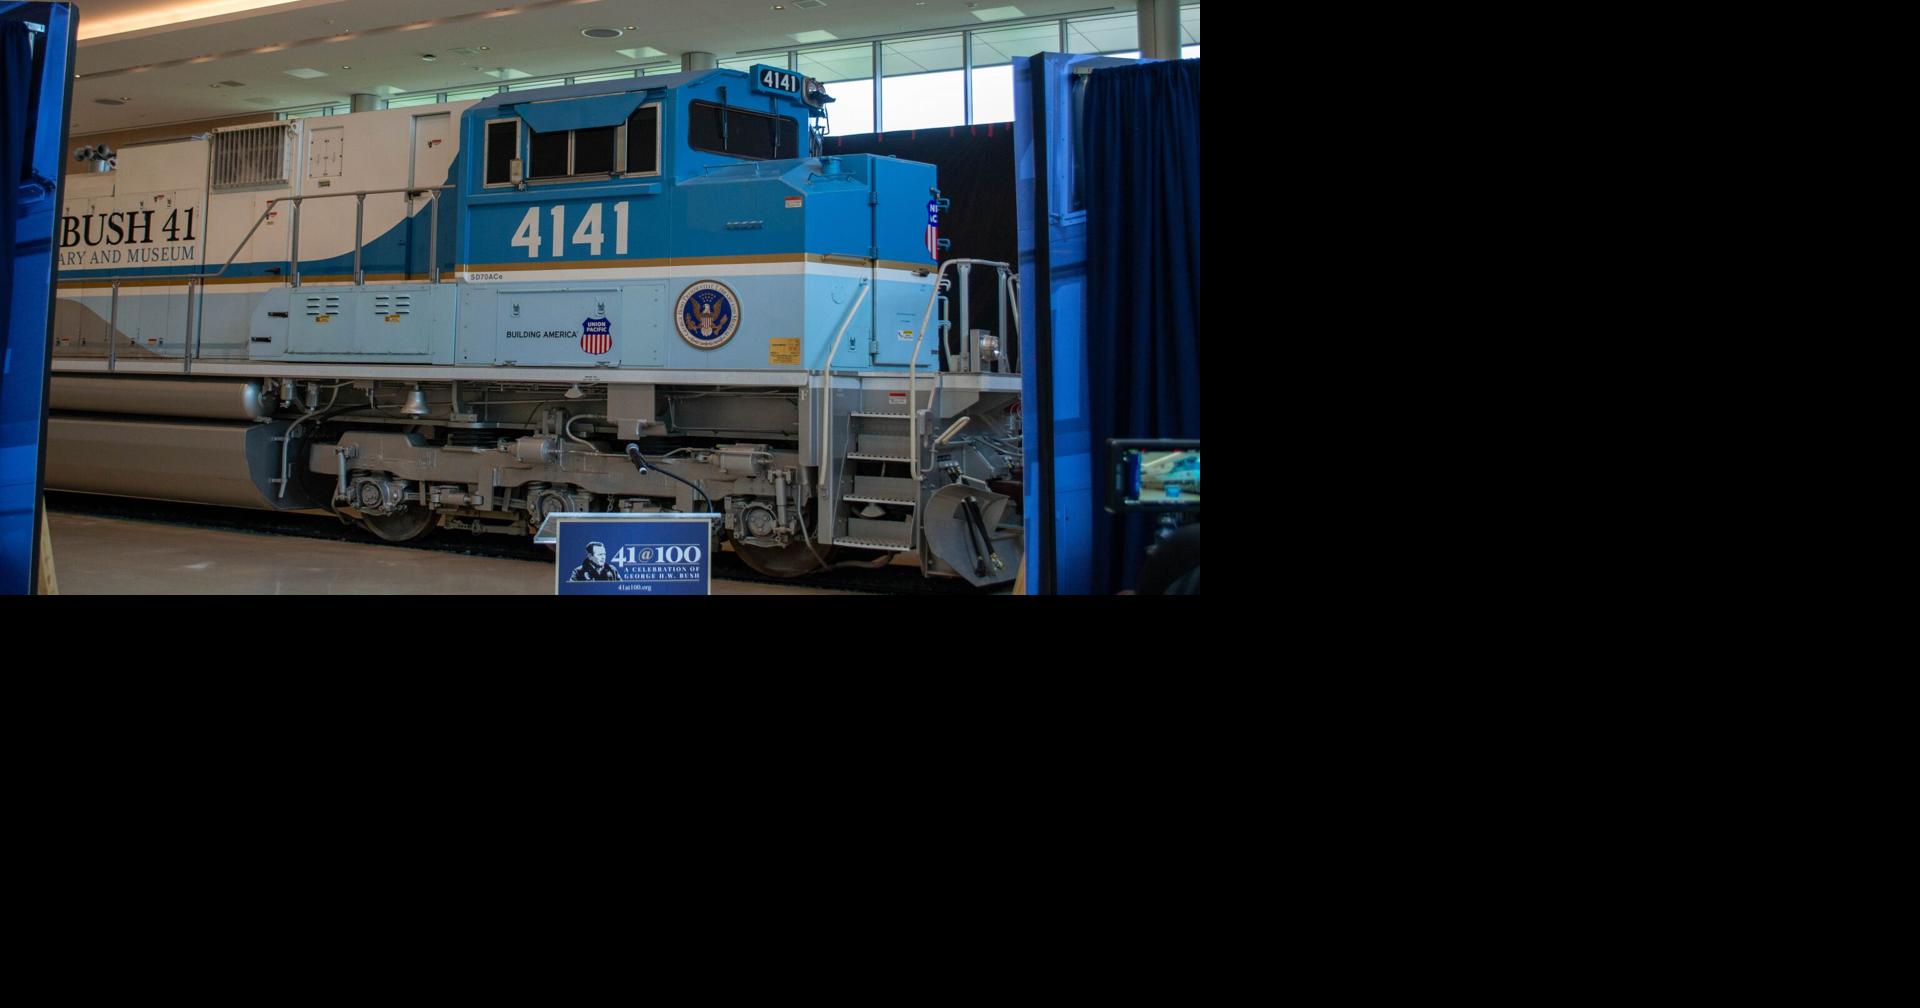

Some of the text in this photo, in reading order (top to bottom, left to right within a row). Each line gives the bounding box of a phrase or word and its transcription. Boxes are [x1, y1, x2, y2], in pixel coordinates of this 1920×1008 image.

[764, 70, 796, 92] 4141
[60, 206, 196, 248] BUSH 41
[511, 201, 629, 258] 4141
[90, 250, 122, 264] AND
[127, 246, 194, 262] MUSEUM
[470, 273, 503, 281] SD70ACe
[506, 330, 577, 339] BUILDING AMERICA
[611, 545, 701, 567] 41@100
[618, 584, 652, 592] 41at100.org
